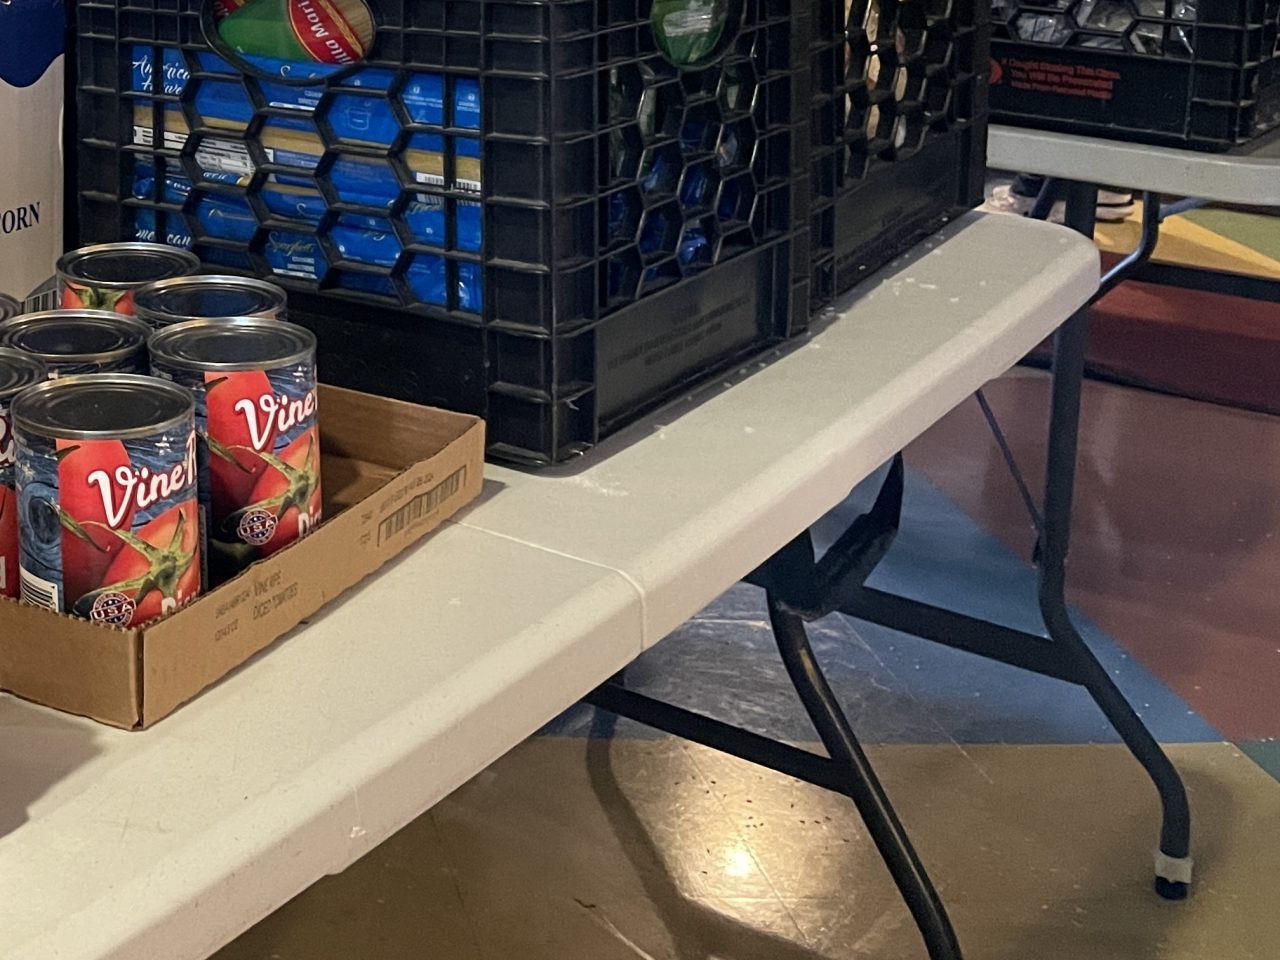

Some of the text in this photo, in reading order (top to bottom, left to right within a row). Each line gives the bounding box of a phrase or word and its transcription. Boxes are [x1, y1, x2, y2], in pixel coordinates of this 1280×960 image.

[235, 393, 314, 451] Vine
[88, 462, 187, 528] Vine
[240, 518, 274, 537] USA
[92, 602, 133, 620] USA
